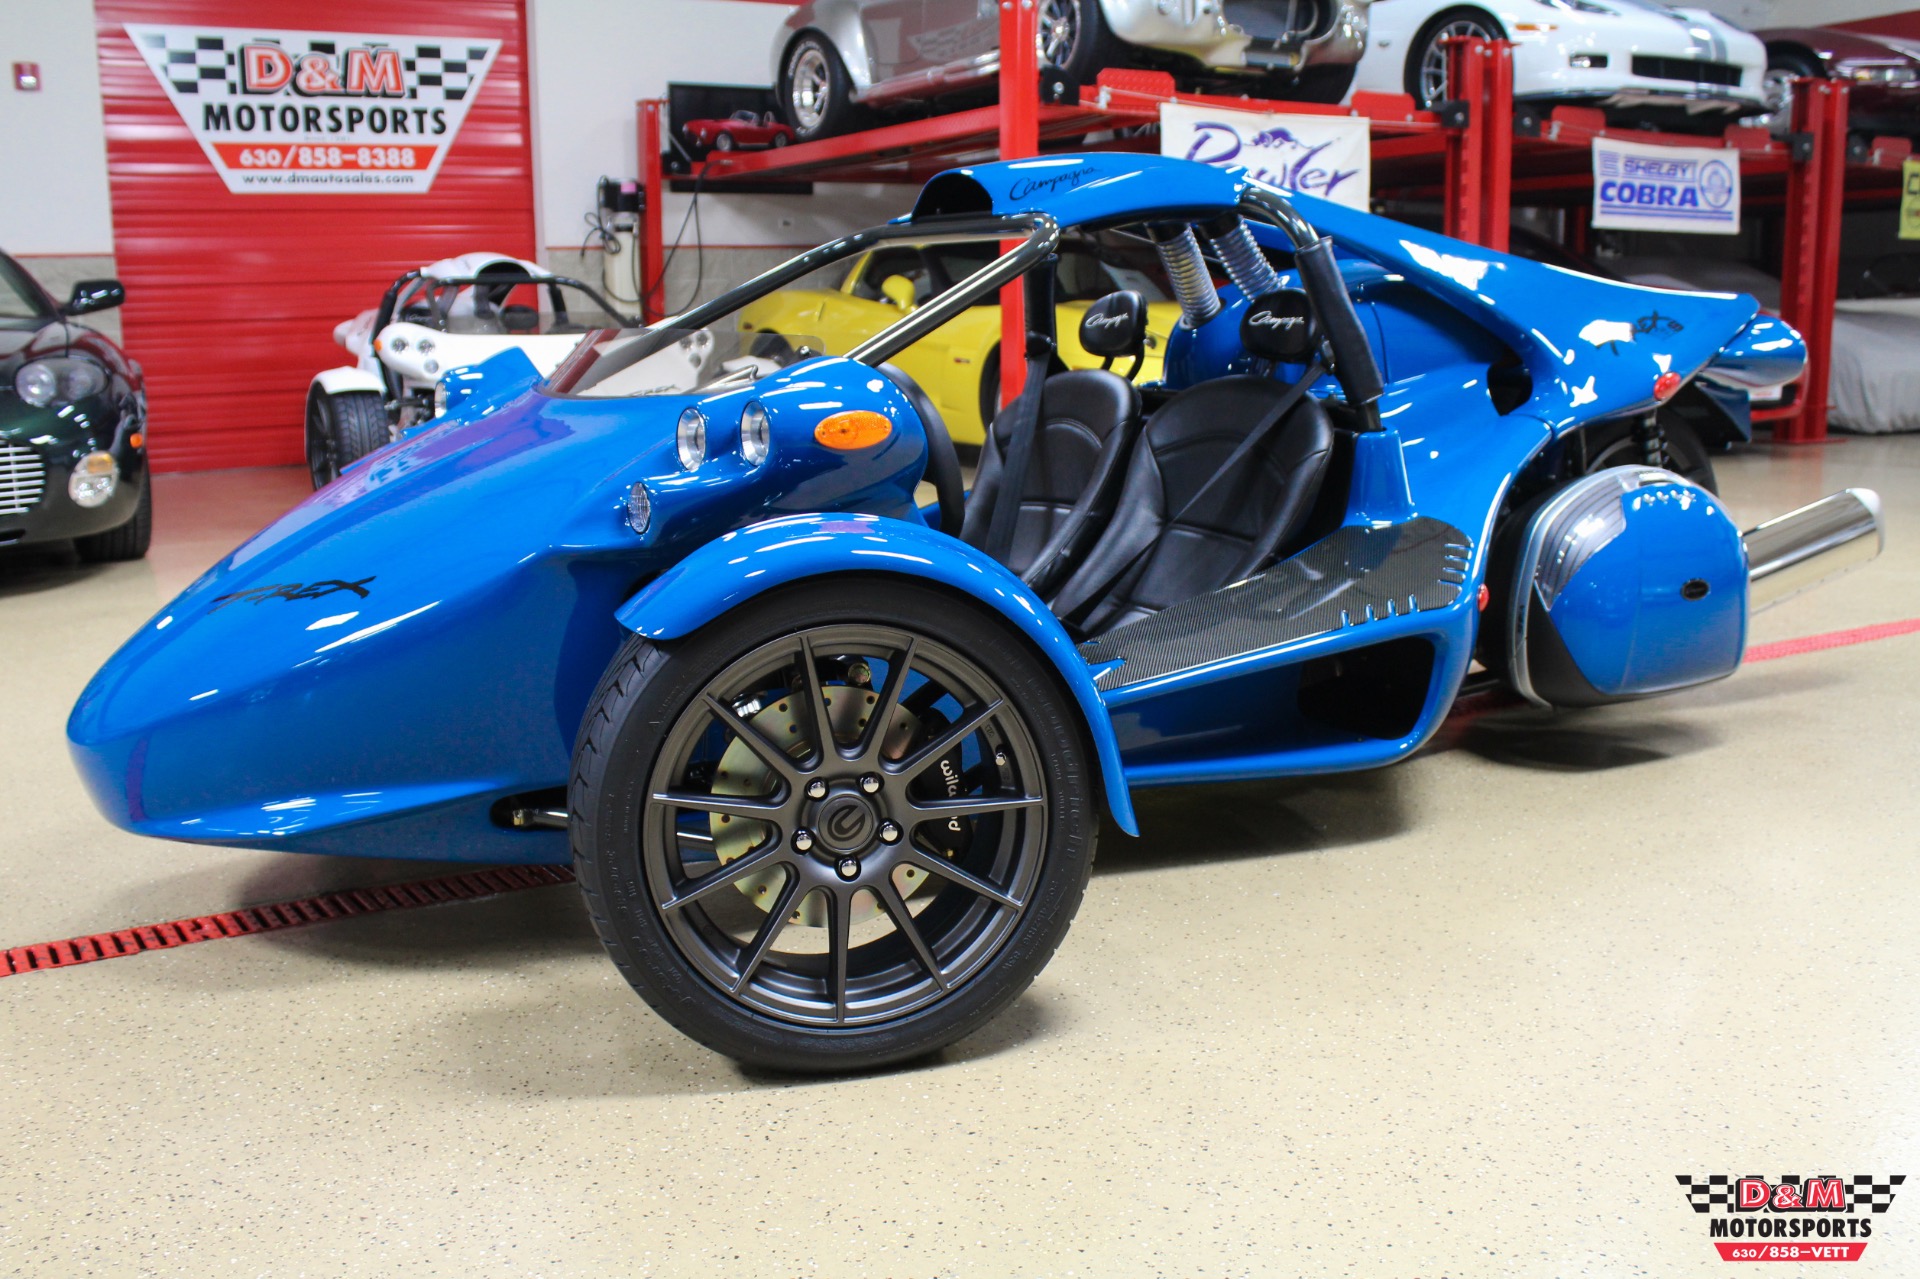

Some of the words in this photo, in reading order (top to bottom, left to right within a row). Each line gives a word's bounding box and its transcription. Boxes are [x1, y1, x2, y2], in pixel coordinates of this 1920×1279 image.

[242, 44, 405, 98] D&M
[203, 104, 447, 134] MOTORSPORTS
[239, 145, 416, 169] 630/858-8388
[1624, 160, 1689, 177] SHELBY
[242, 172, 414, 185] www.dmautosales.com
[1009, 166, 1103, 201] Campagna
[1601, 181, 1699, 207] COBRA
